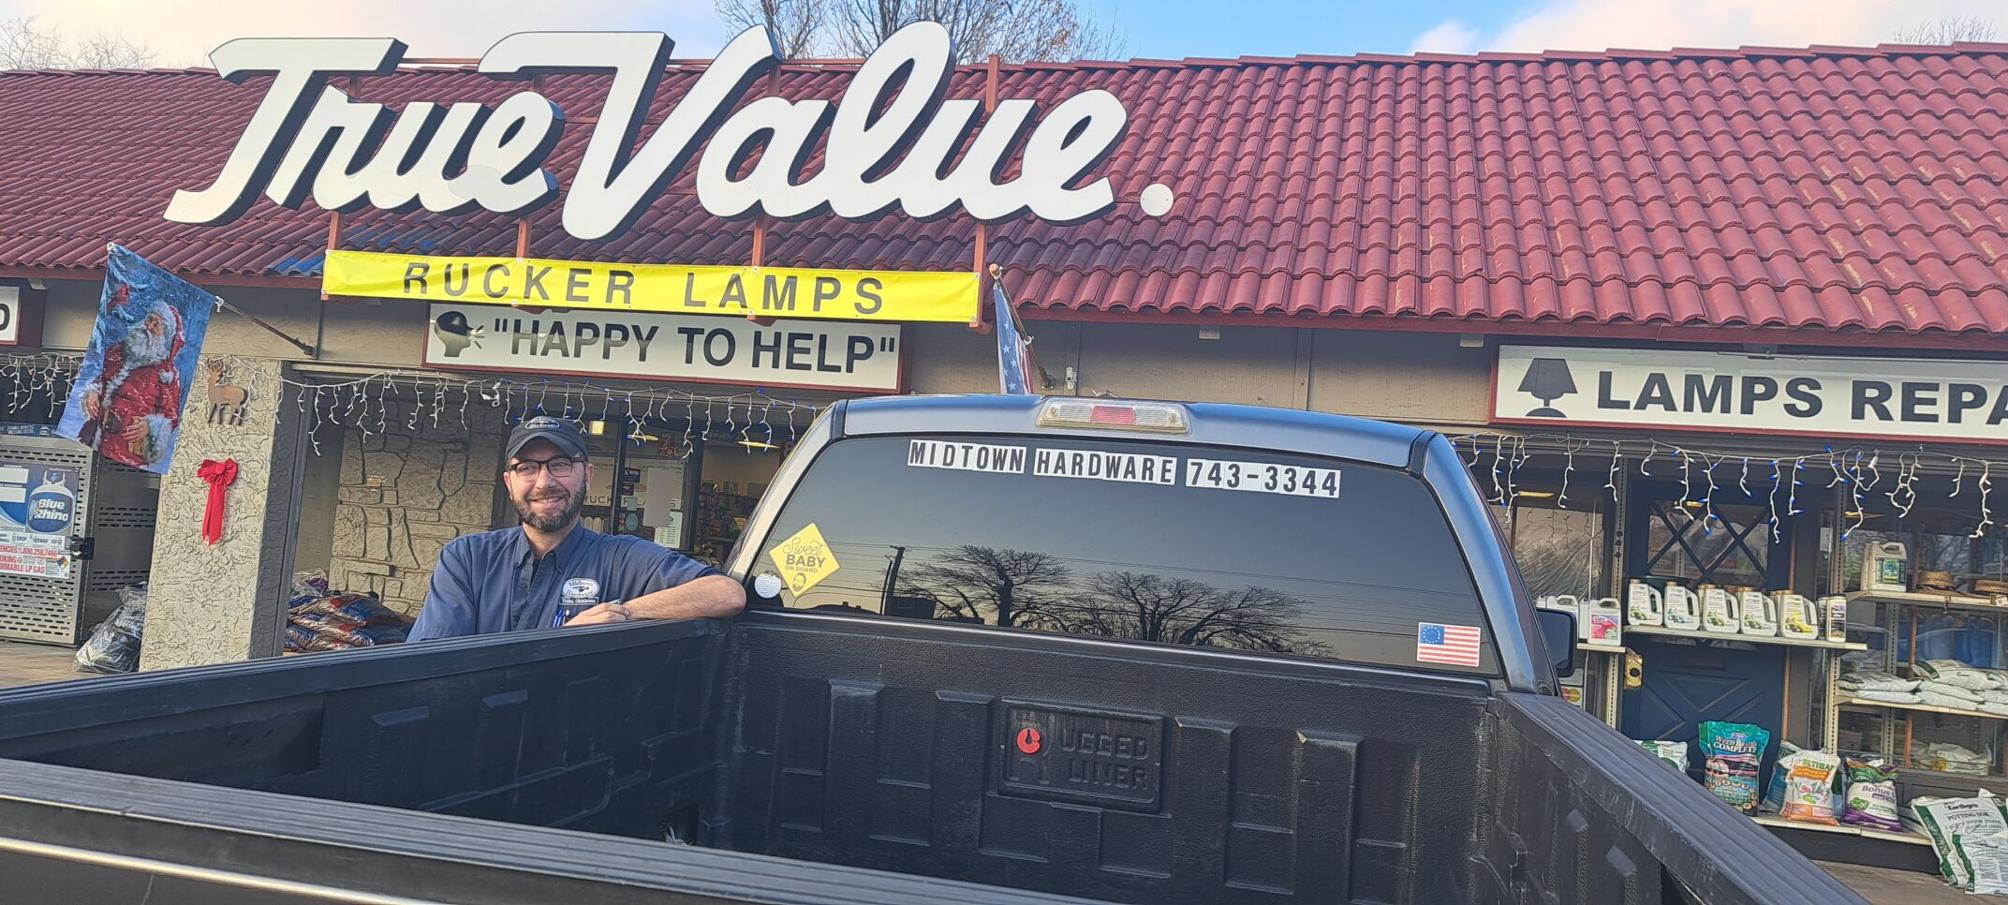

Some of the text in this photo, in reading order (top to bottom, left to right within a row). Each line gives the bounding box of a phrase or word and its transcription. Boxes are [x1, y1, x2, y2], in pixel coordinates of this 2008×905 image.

[164, 37, 560, 226] True
[403, 261, 883, 315] RUCKER LAMPS
[494, 317, 896, 374] "HAPPY TO HELP"
[1597, 370, 1823, 419] LAMPS
[909, 441, 1338, 497] MIDTOWN HARDWARE 743-3344
[38, 498, 65, 510] Blue
[783, 537, 823, 556] Sweet
[786, 554, 826, 568] BABY
[1068, 757, 1149, 791] LINER
